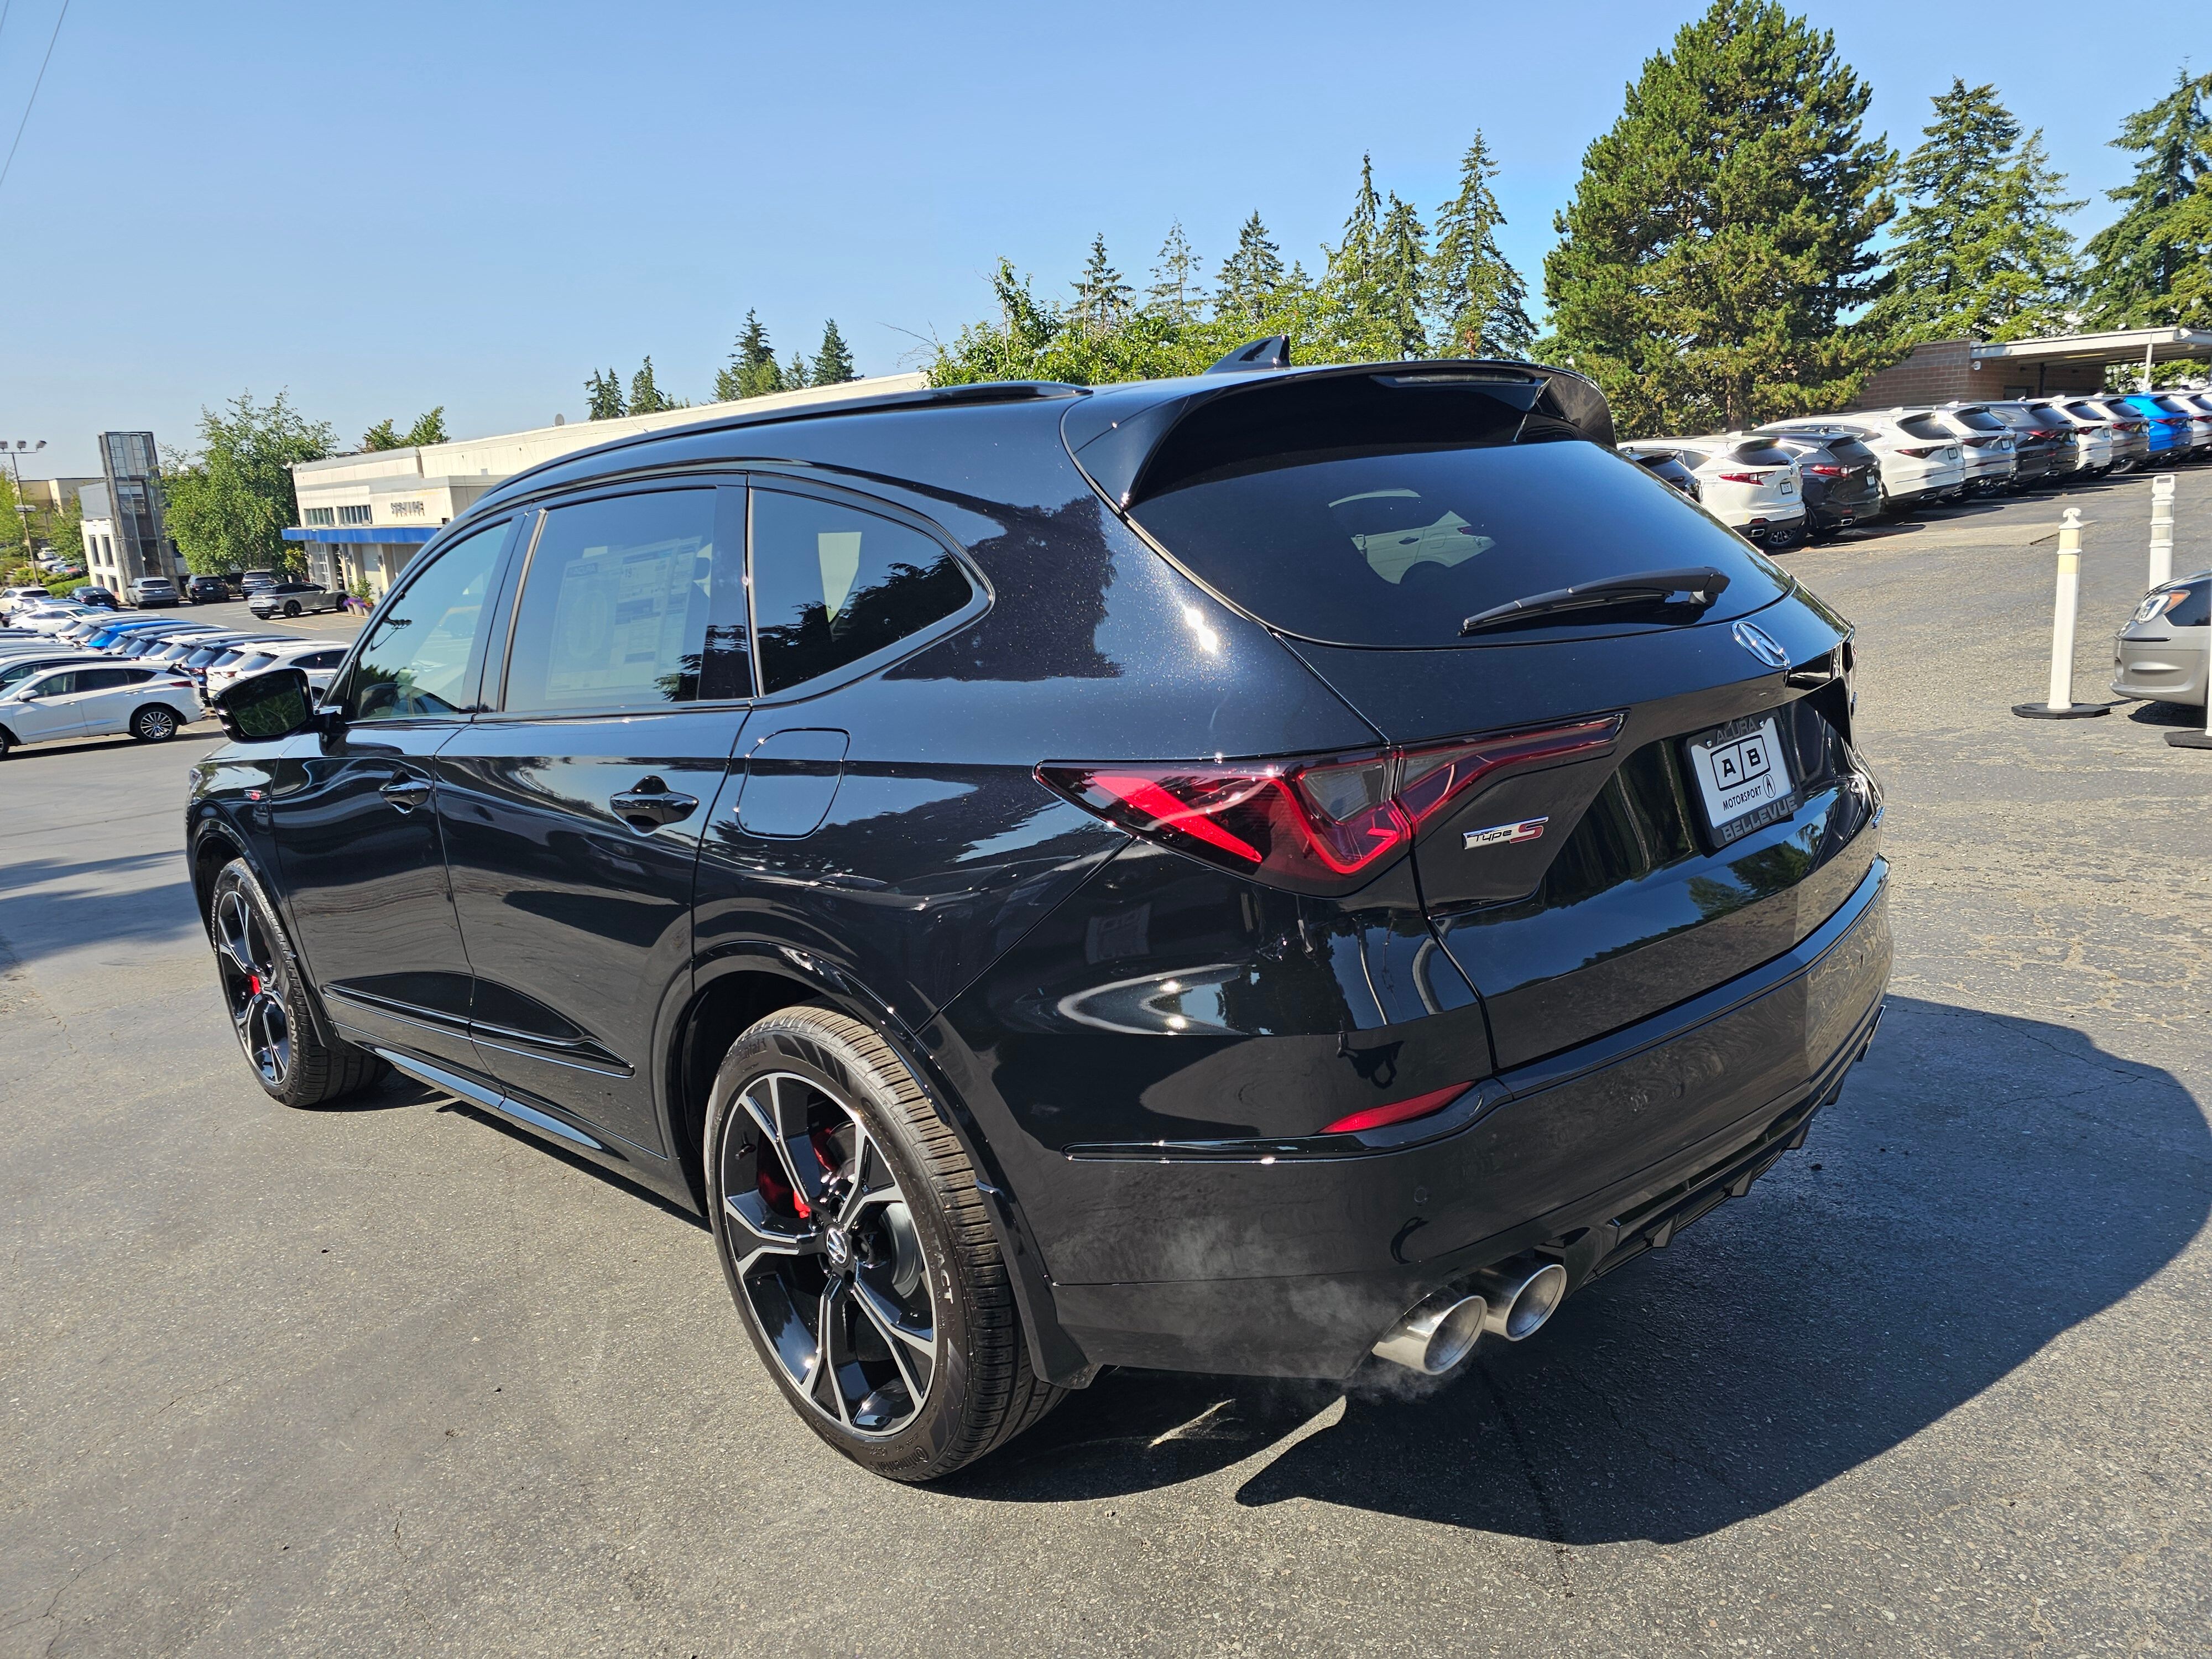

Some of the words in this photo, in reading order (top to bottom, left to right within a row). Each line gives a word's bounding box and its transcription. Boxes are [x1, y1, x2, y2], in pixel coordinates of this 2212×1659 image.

[1717, 718, 1757, 744] ACURA
[1721, 758, 1736, 778] A
[1746, 748, 1761, 767] B
[1723, 785, 1762, 811] MOTORSPORT
[1509, 817, 1549, 844] S
[1721, 795, 1798, 842] BELLEVUE
